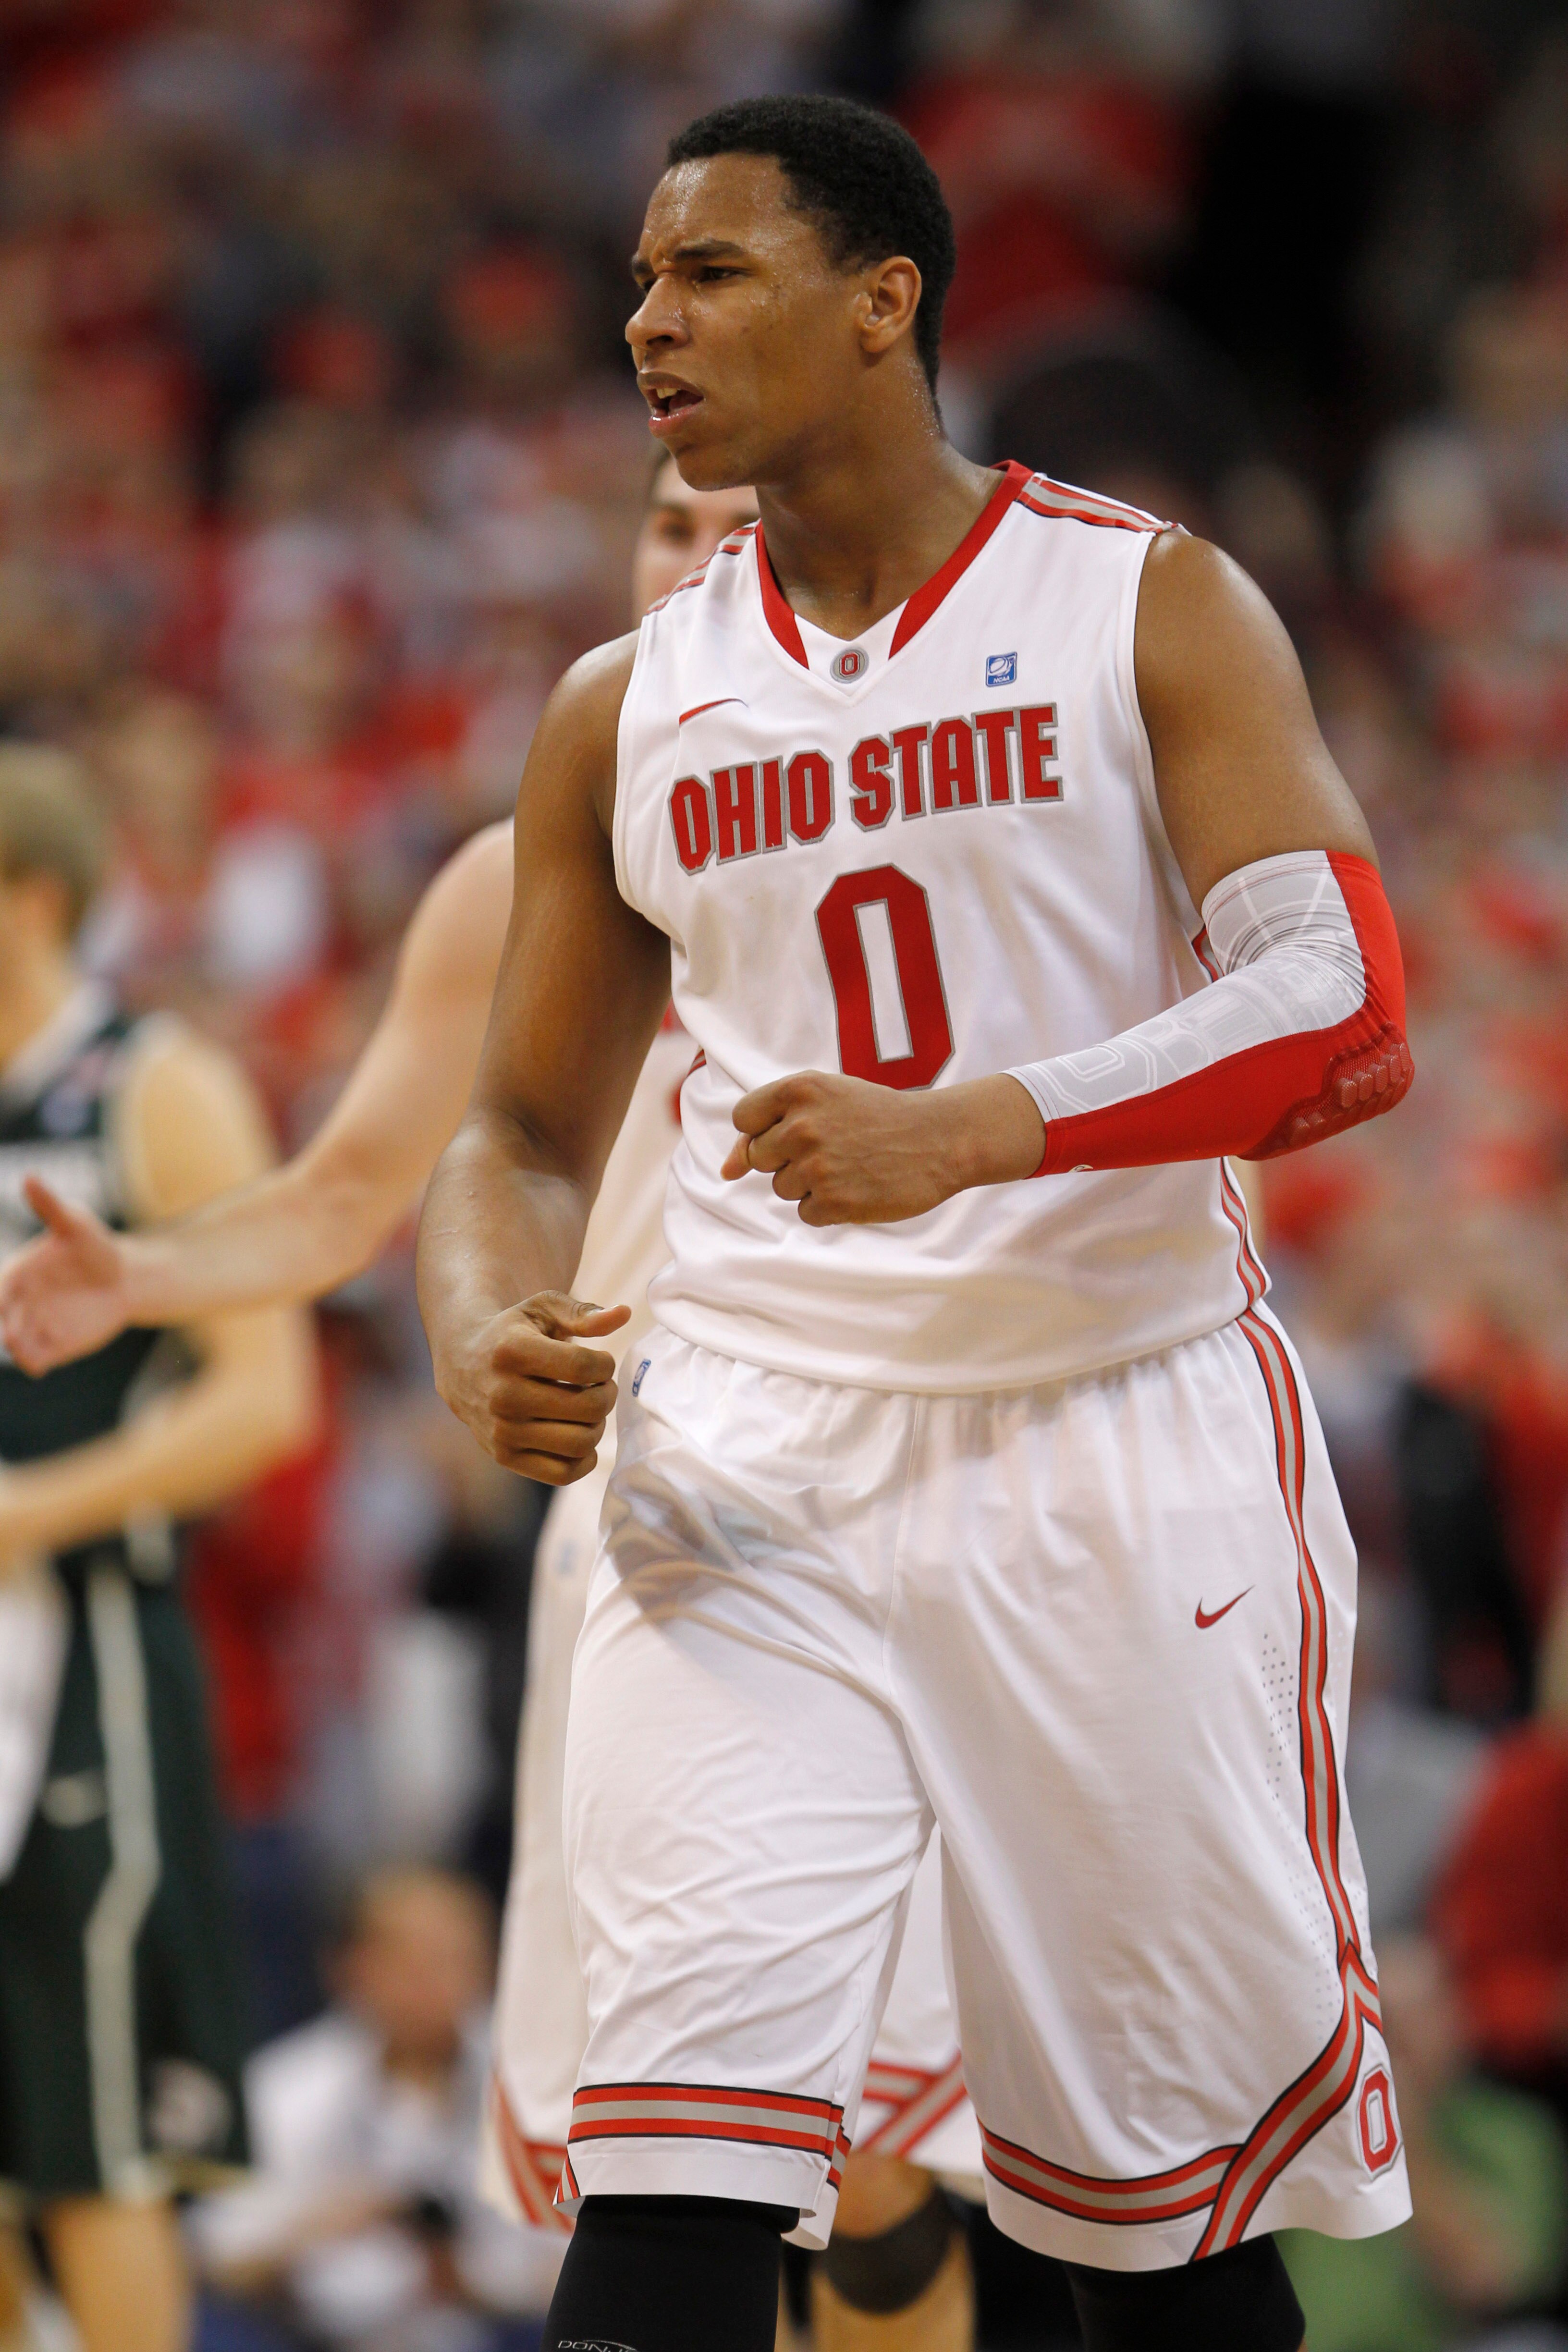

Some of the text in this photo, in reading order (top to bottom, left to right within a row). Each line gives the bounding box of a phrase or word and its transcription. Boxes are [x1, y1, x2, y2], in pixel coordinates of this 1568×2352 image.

[668, 702, 1064, 876] OHIO STATE
[814, 862, 956, 1091] 0
[558, 2340, 630, 2352] DON
